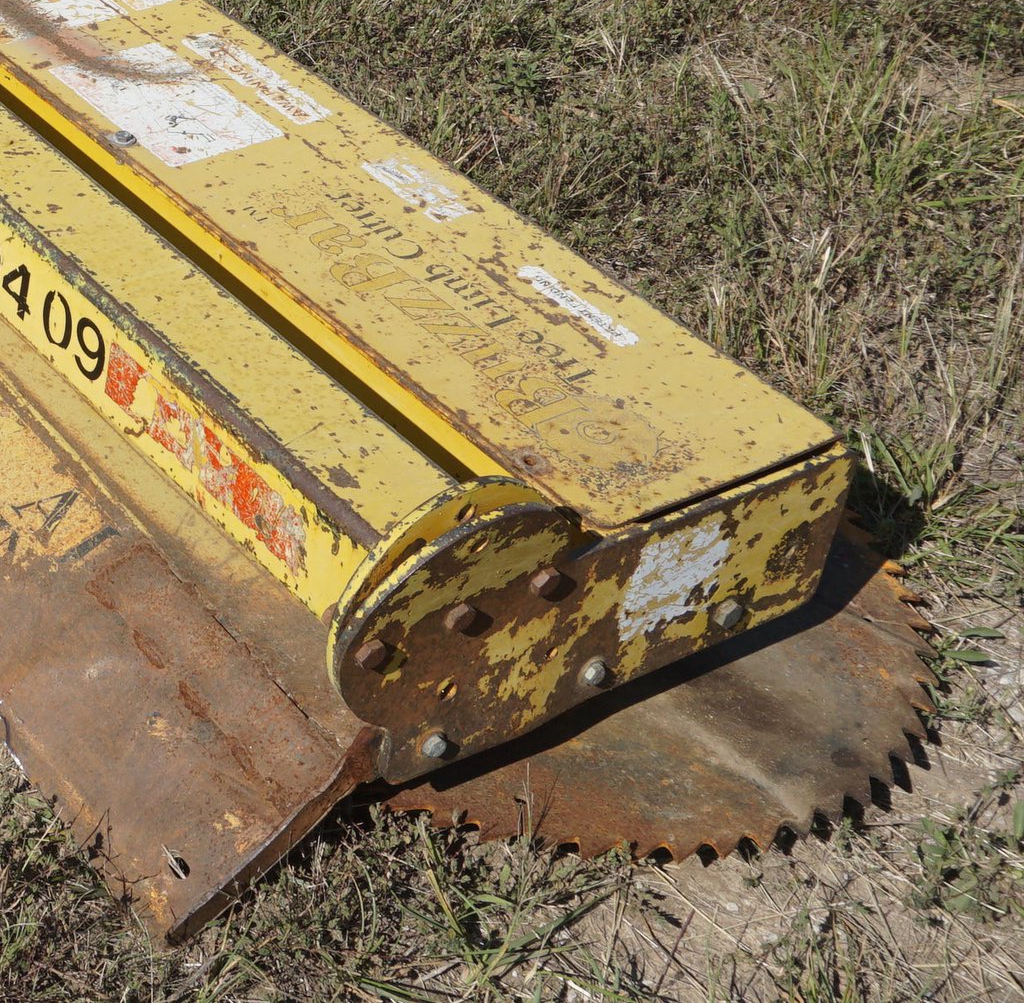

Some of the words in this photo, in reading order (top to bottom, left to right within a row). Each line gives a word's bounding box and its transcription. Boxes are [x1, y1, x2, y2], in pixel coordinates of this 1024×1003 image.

[324, 190, 425, 261] Cutter
[424, 262, 521, 332] Limb
[516, 329, 598, 390] Tree
